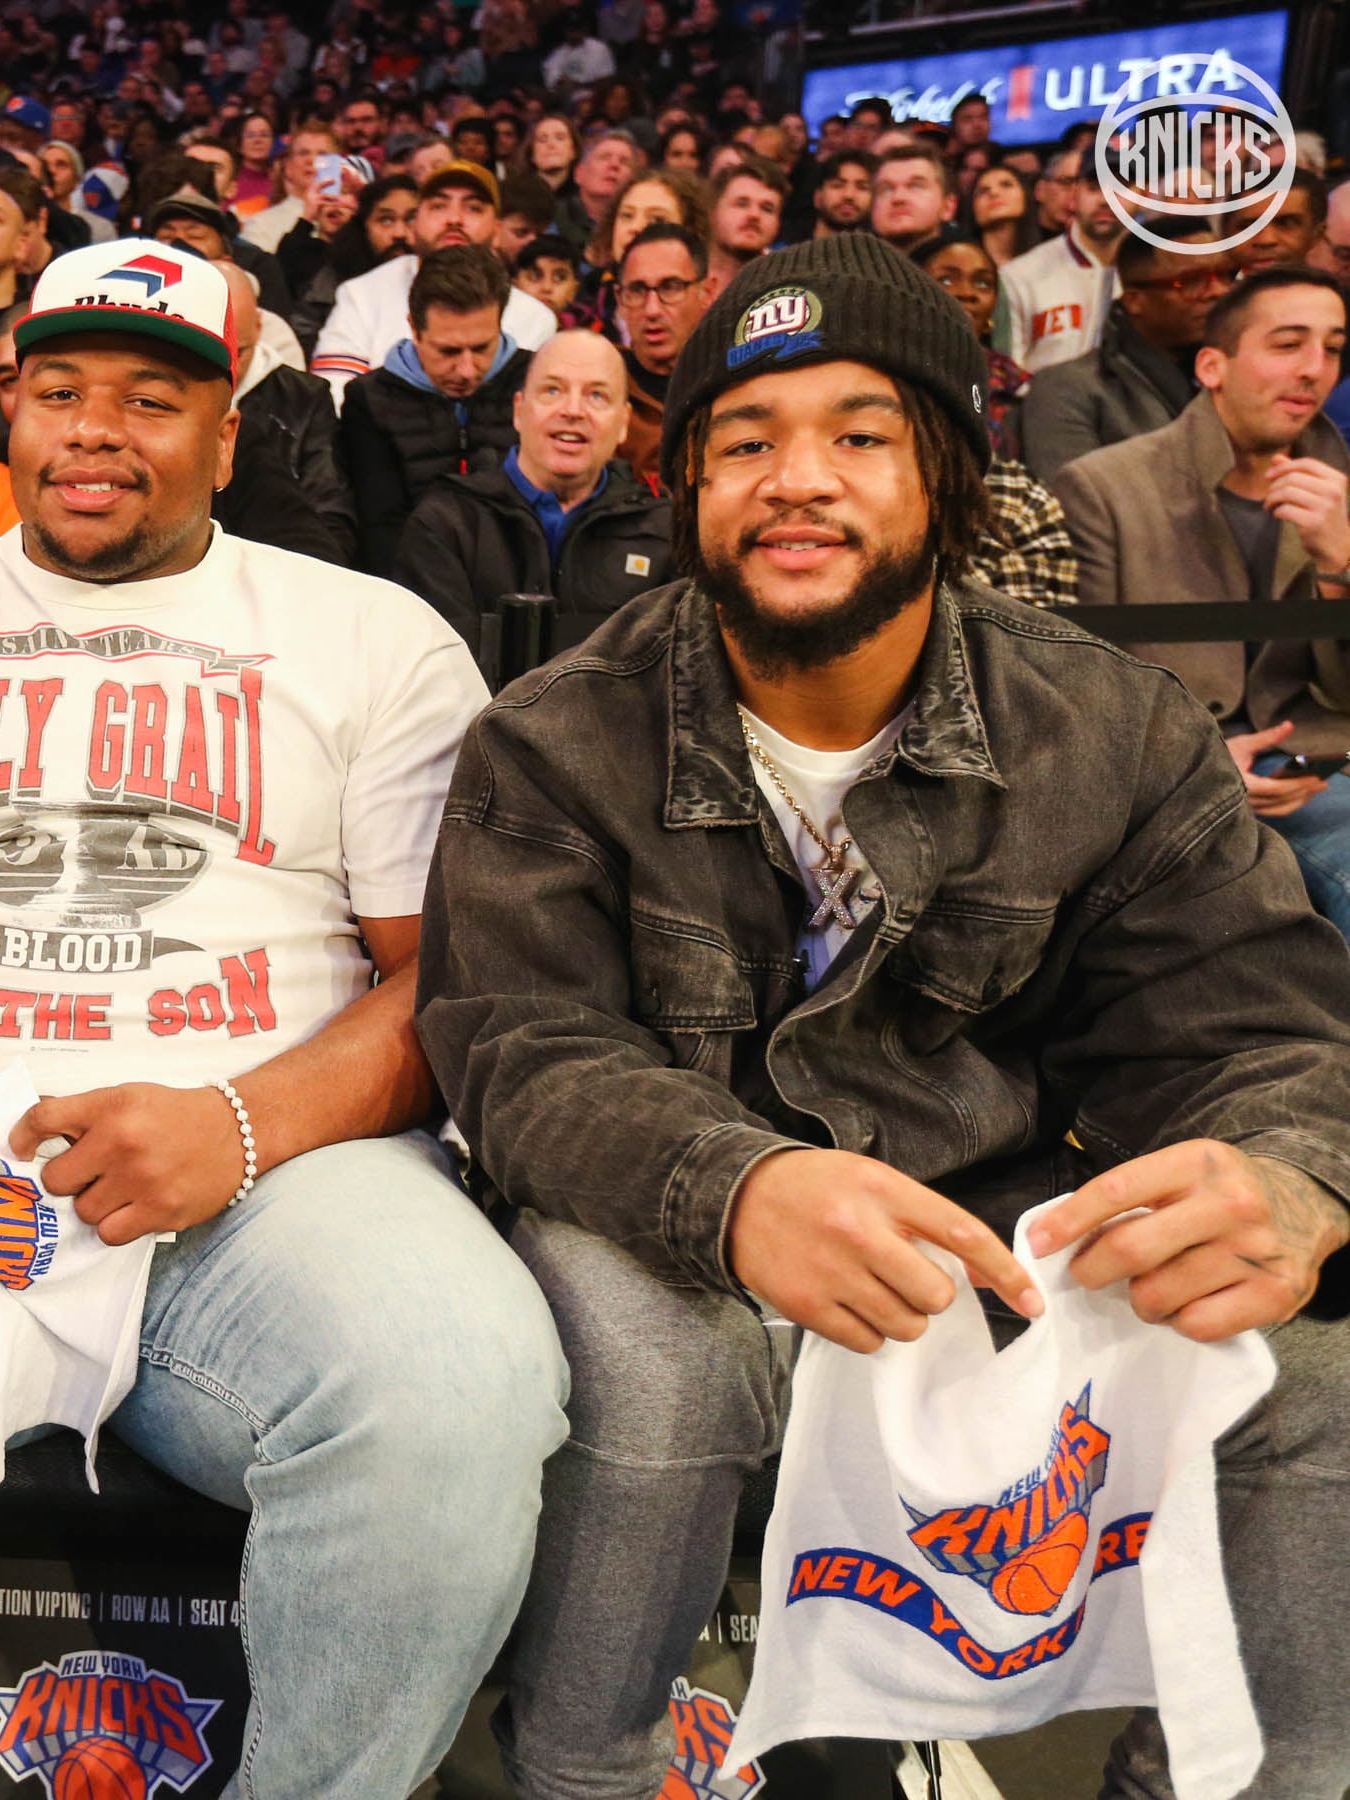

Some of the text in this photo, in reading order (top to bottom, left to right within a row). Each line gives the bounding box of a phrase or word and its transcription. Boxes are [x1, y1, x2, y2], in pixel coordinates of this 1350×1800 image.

[1045, 48, 1246, 111] ULTRA
[85, 663, 279, 866] GRAIL
[1, 927, 143, 973] BLOOD
[146, 947, 277, 1039] SON
[910, 1404, 1110, 1555] KNICKS
[111, 1594, 146, 1622] ROW
[150, 1597, 171, 1625] AA
[190, 1598, 227, 1627] SEAT
[790, 1556, 921, 1608] NEW
[929, 1598, 1068, 1678] YORK
[61, 1655, 145, 1680] NEW YORK
